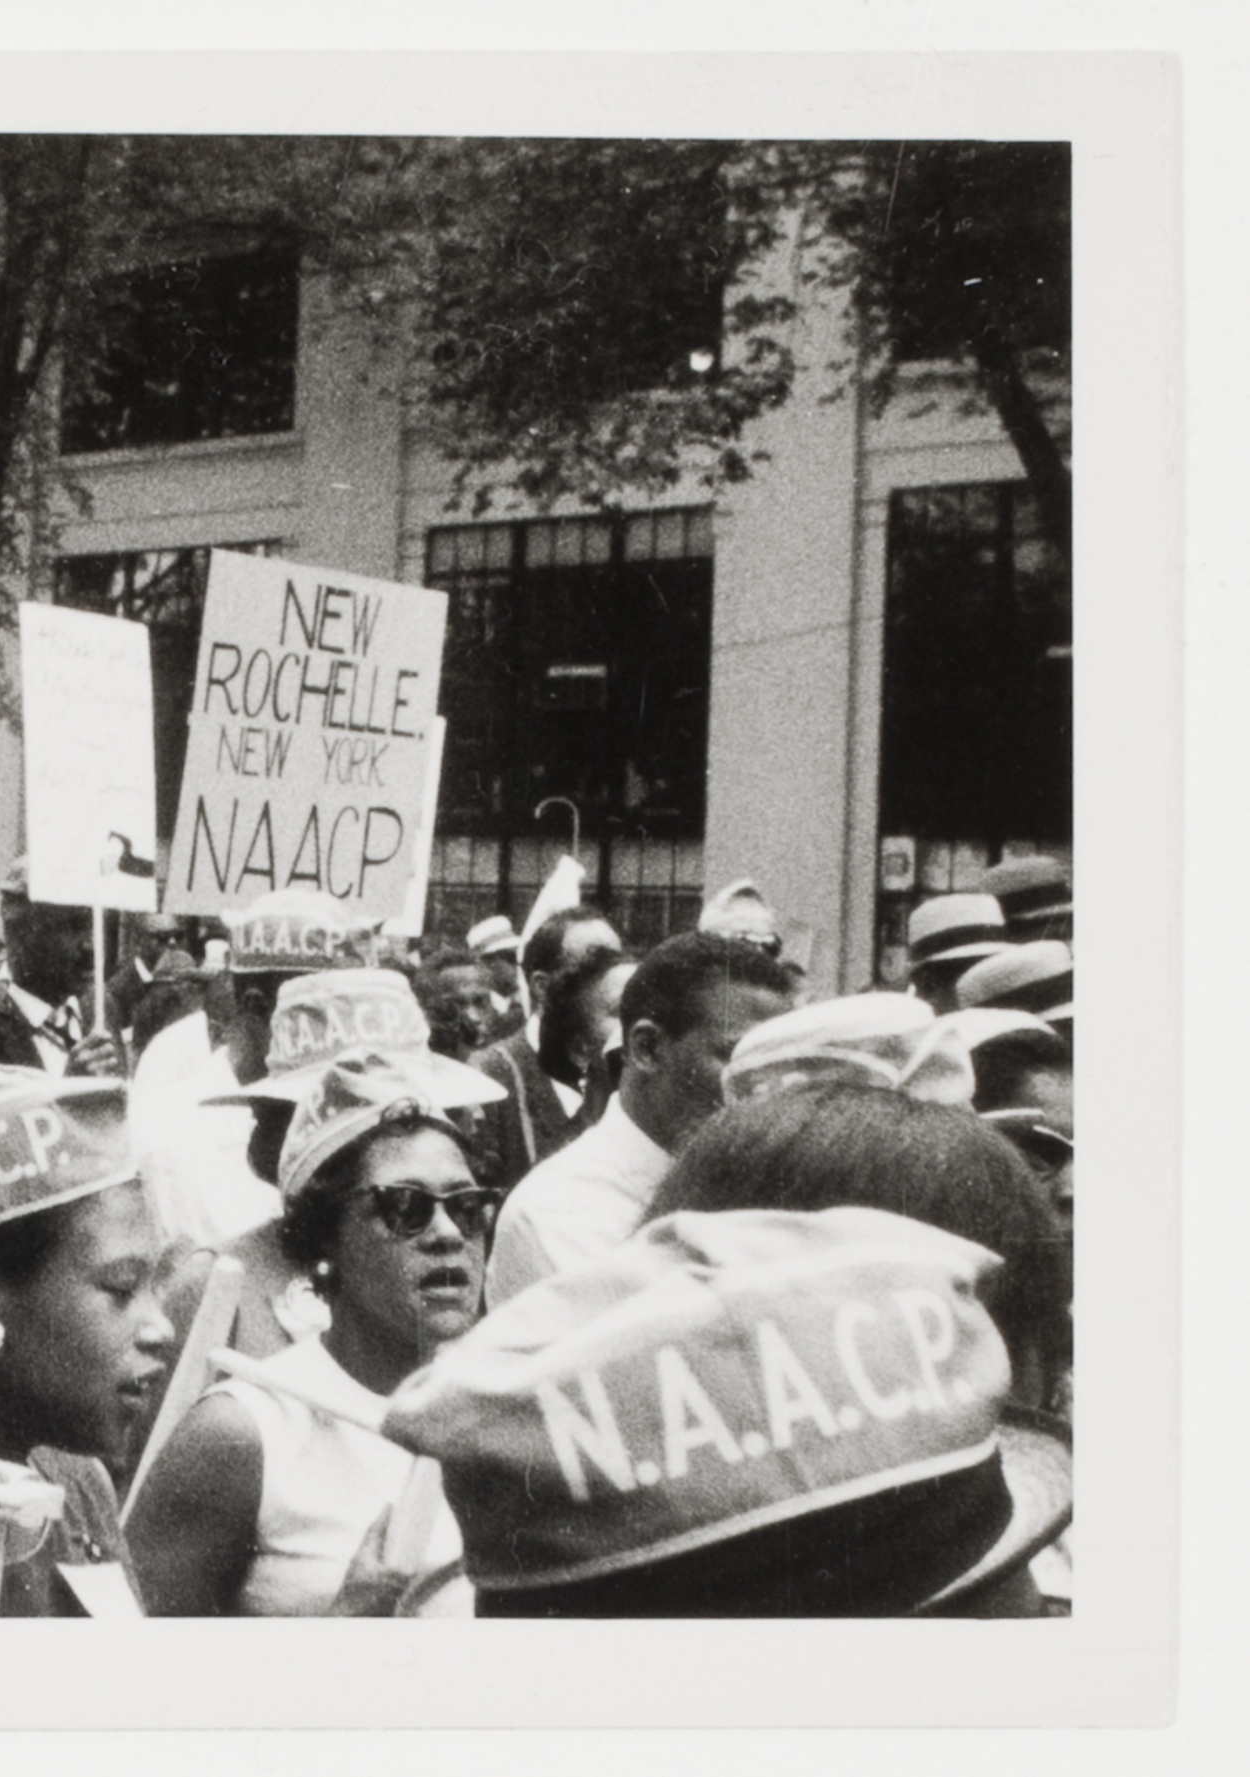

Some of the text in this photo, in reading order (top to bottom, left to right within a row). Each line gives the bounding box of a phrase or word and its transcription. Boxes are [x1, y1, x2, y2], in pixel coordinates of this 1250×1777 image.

[280, 579, 382, 657] NEW
[217, 724, 390, 788] NEW YORK
[186, 794, 405, 899] NAACP
[537, 1289, 973, 1501] N.A.A.C.P.
